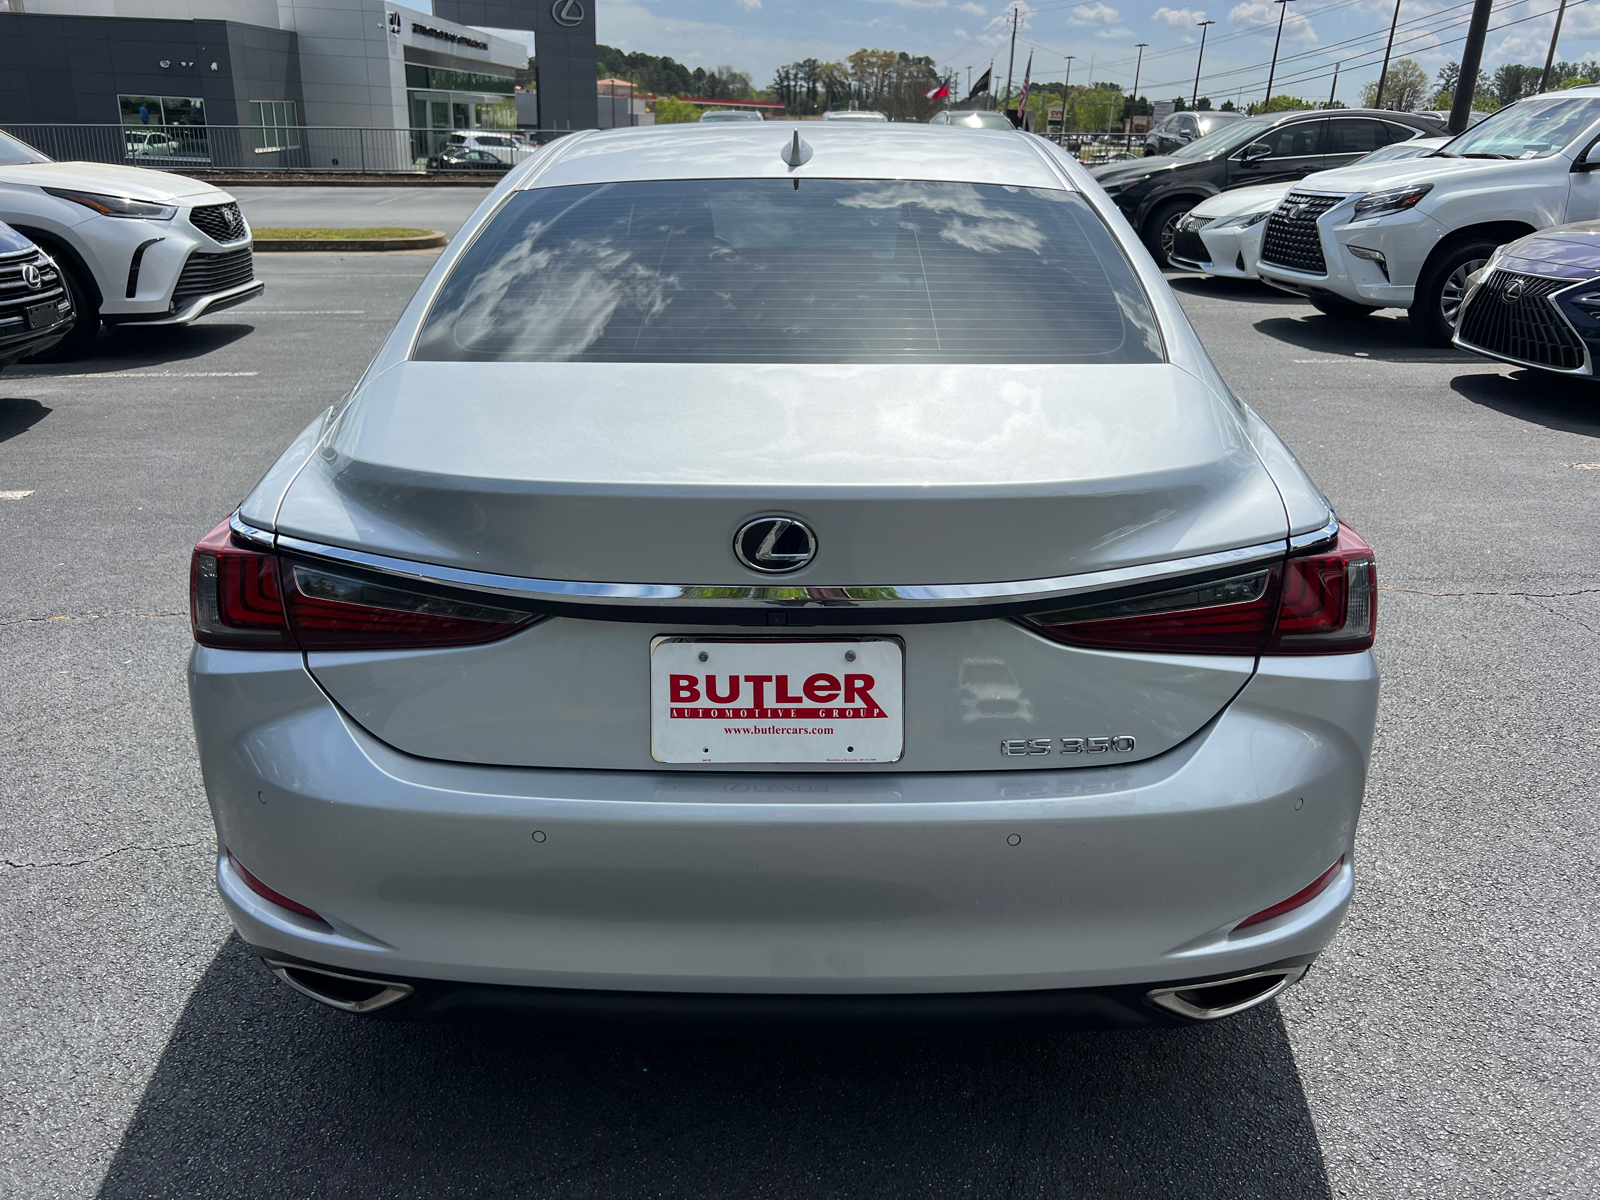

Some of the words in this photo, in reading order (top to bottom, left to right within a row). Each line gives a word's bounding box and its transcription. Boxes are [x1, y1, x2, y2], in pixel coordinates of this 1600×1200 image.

[671, 708, 798, 718] AUTOMOTIVE
[818, 708, 881, 718] GROUP
[724, 725, 835, 736] www.butlercars.com
[1000, 737, 1053, 757] ES
[1060, 734, 1137, 755] 350
[753, 783, 830, 793] LEXUS
